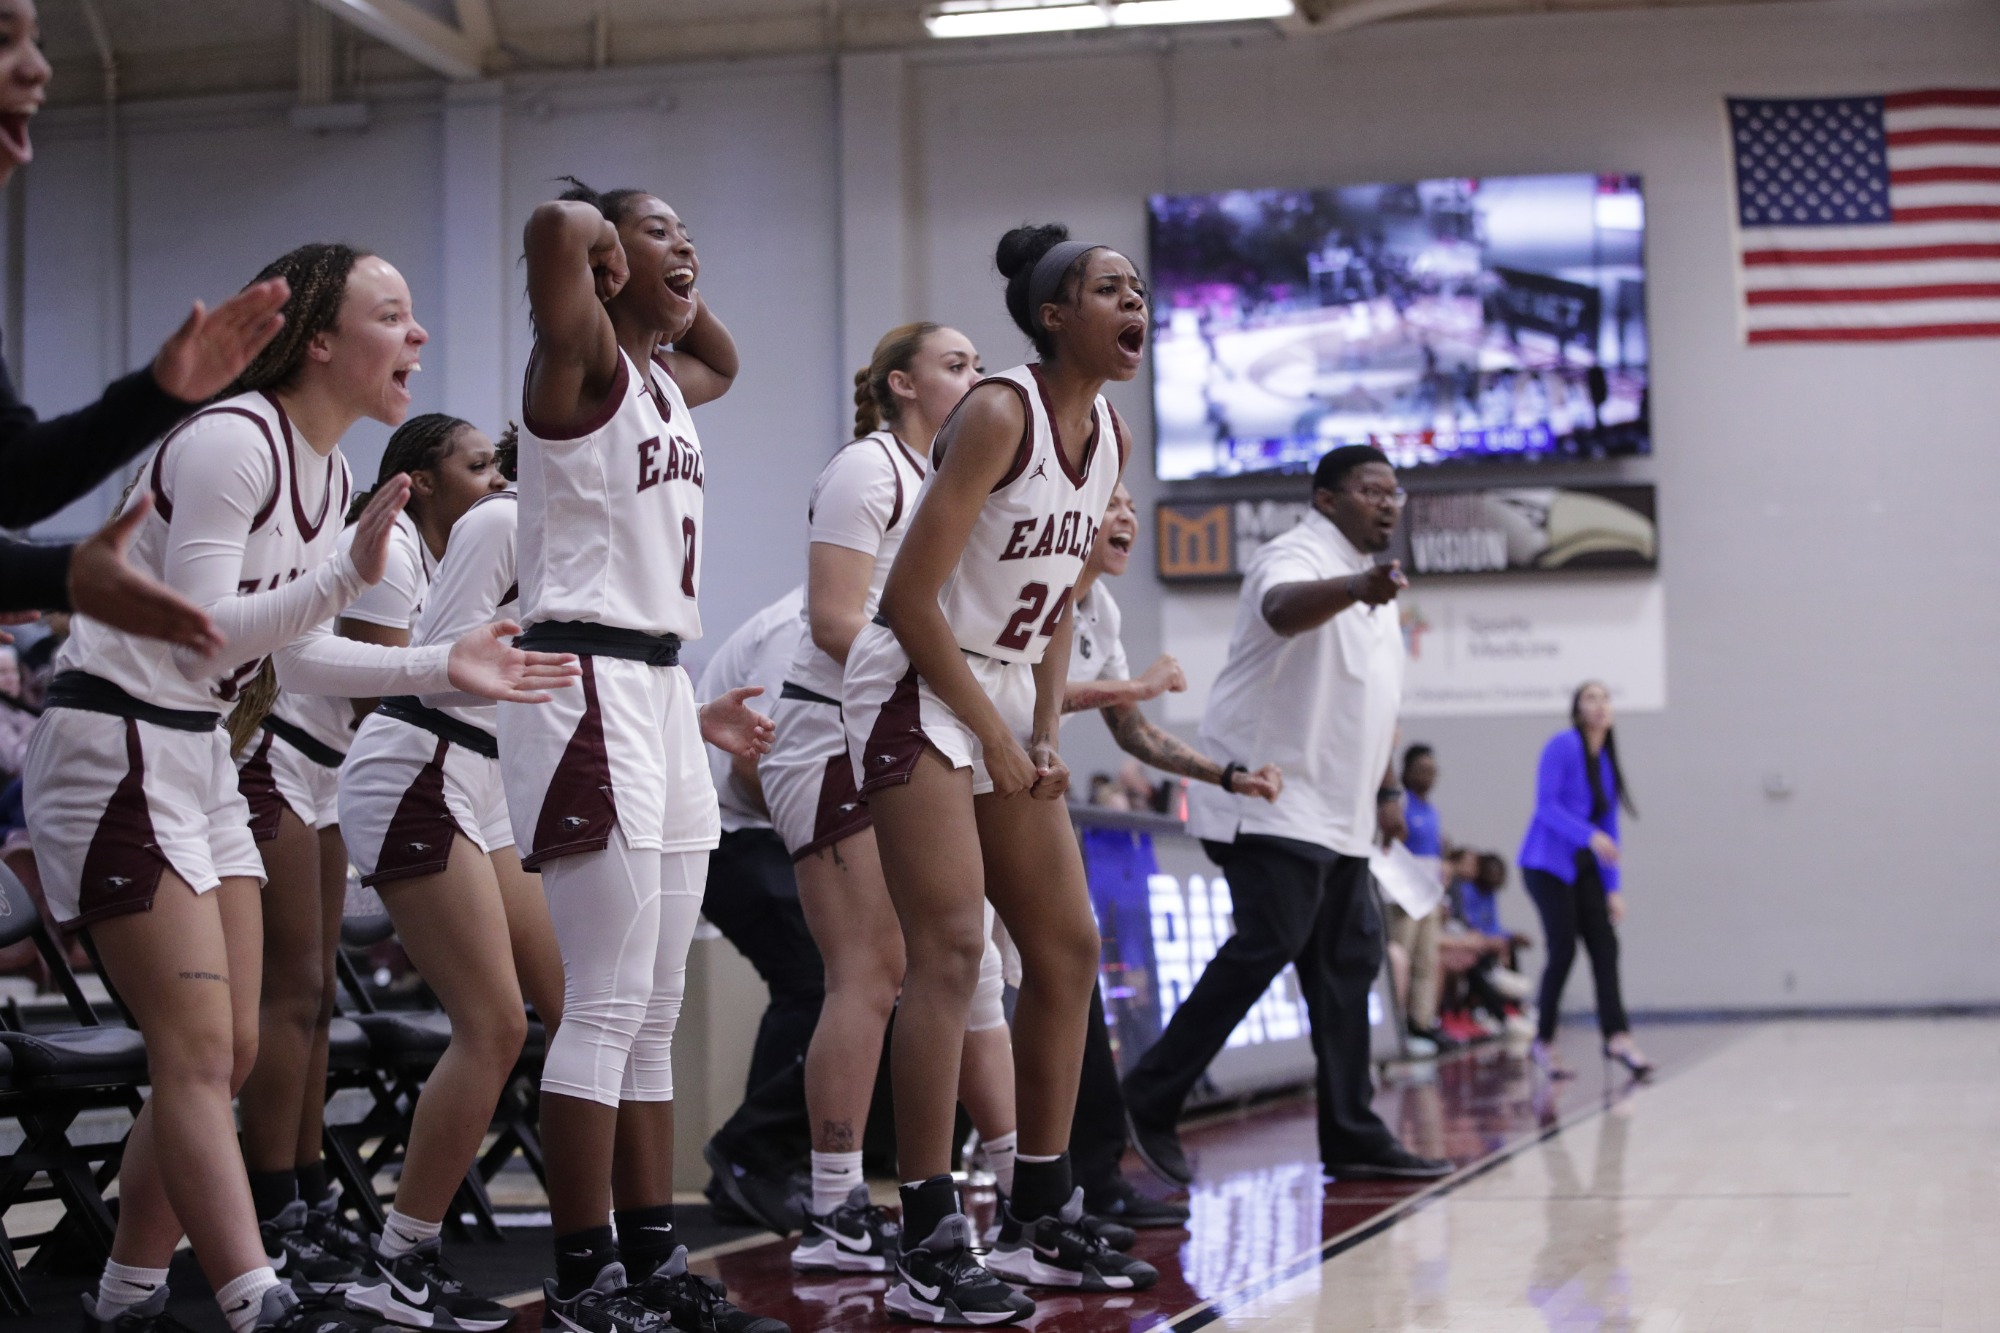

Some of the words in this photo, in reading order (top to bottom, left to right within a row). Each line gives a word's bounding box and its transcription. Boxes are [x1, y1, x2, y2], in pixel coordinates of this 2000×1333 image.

[637, 433, 705, 494] EAGL
[680, 513, 696, 601] 0
[1410, 532, 1507, 572] VISION
[993, 580, 1075, 653] 24
